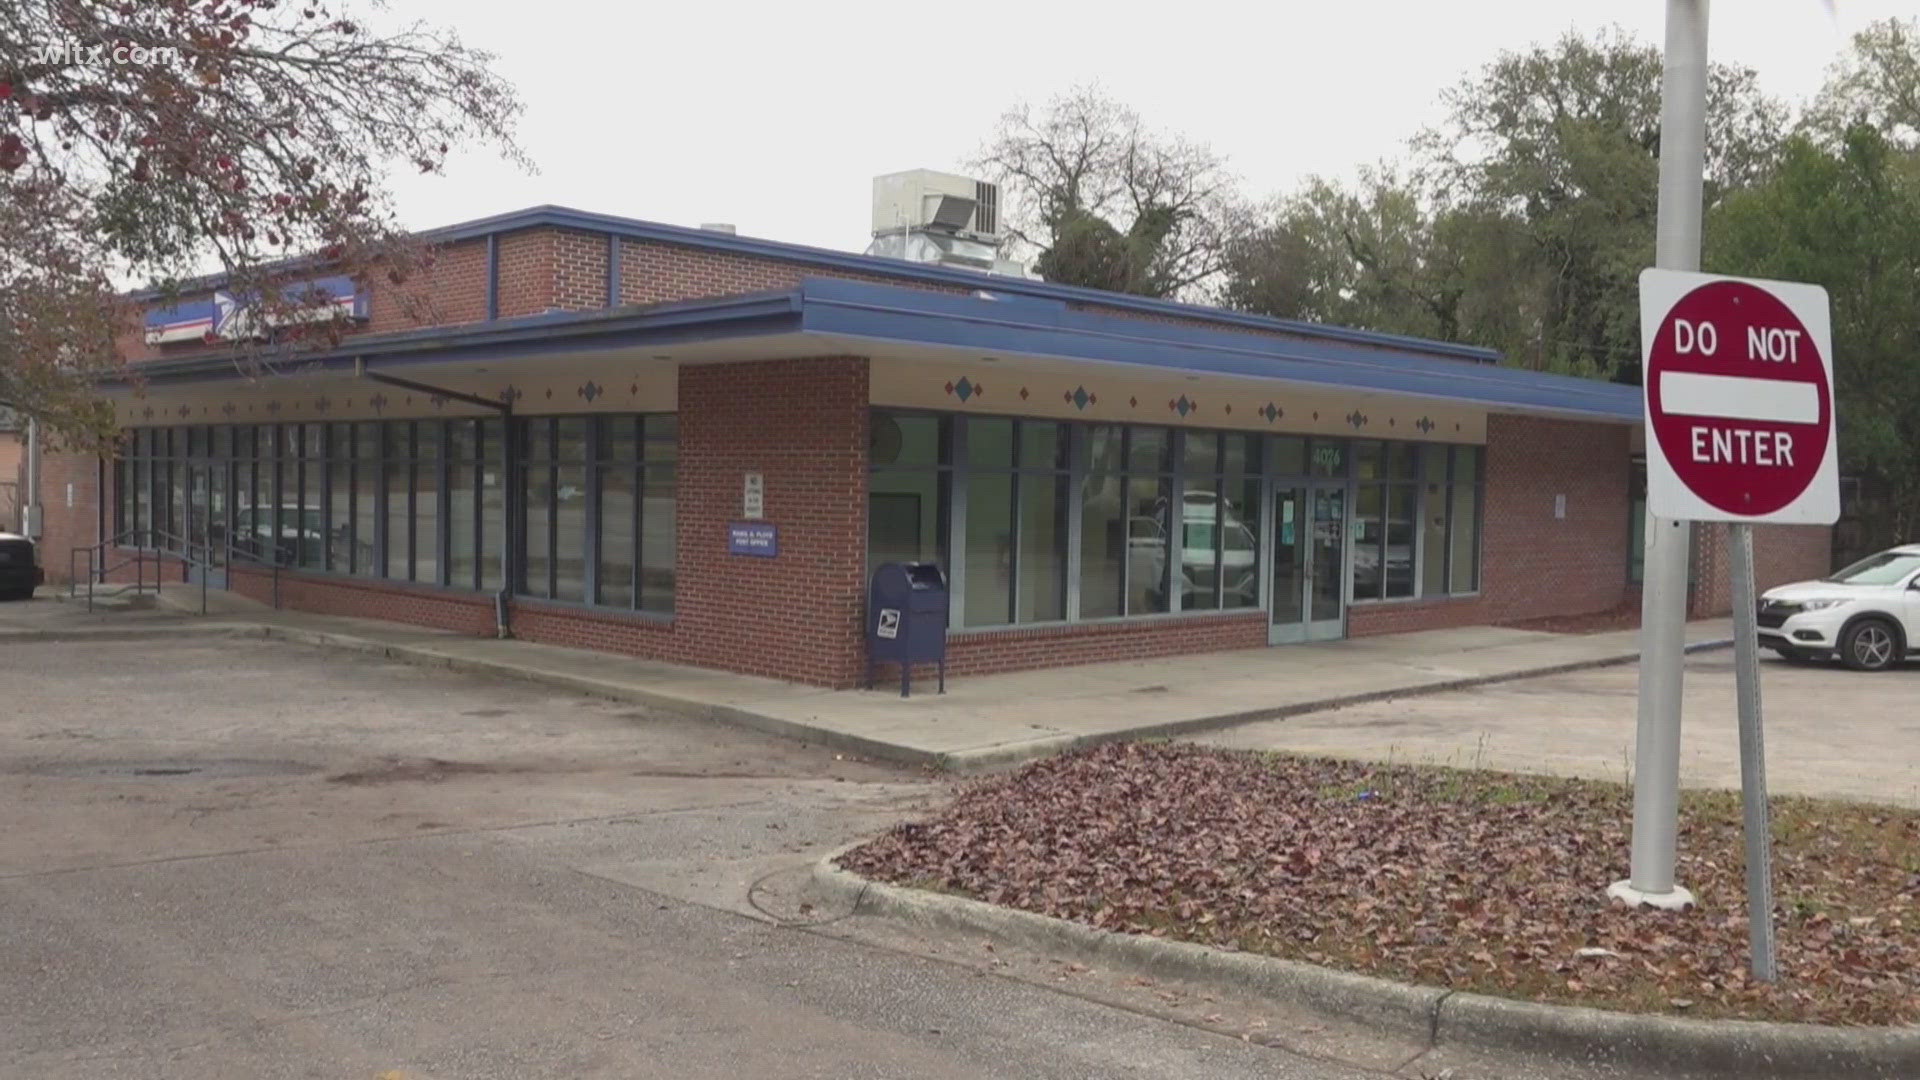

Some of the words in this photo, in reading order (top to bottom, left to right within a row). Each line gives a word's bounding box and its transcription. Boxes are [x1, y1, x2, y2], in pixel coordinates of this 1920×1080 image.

[1674, 318, 1718, 356] DO
[1747, 325, 1801, 364] NOT
[1691, 426, 1794, 467] ENTER
